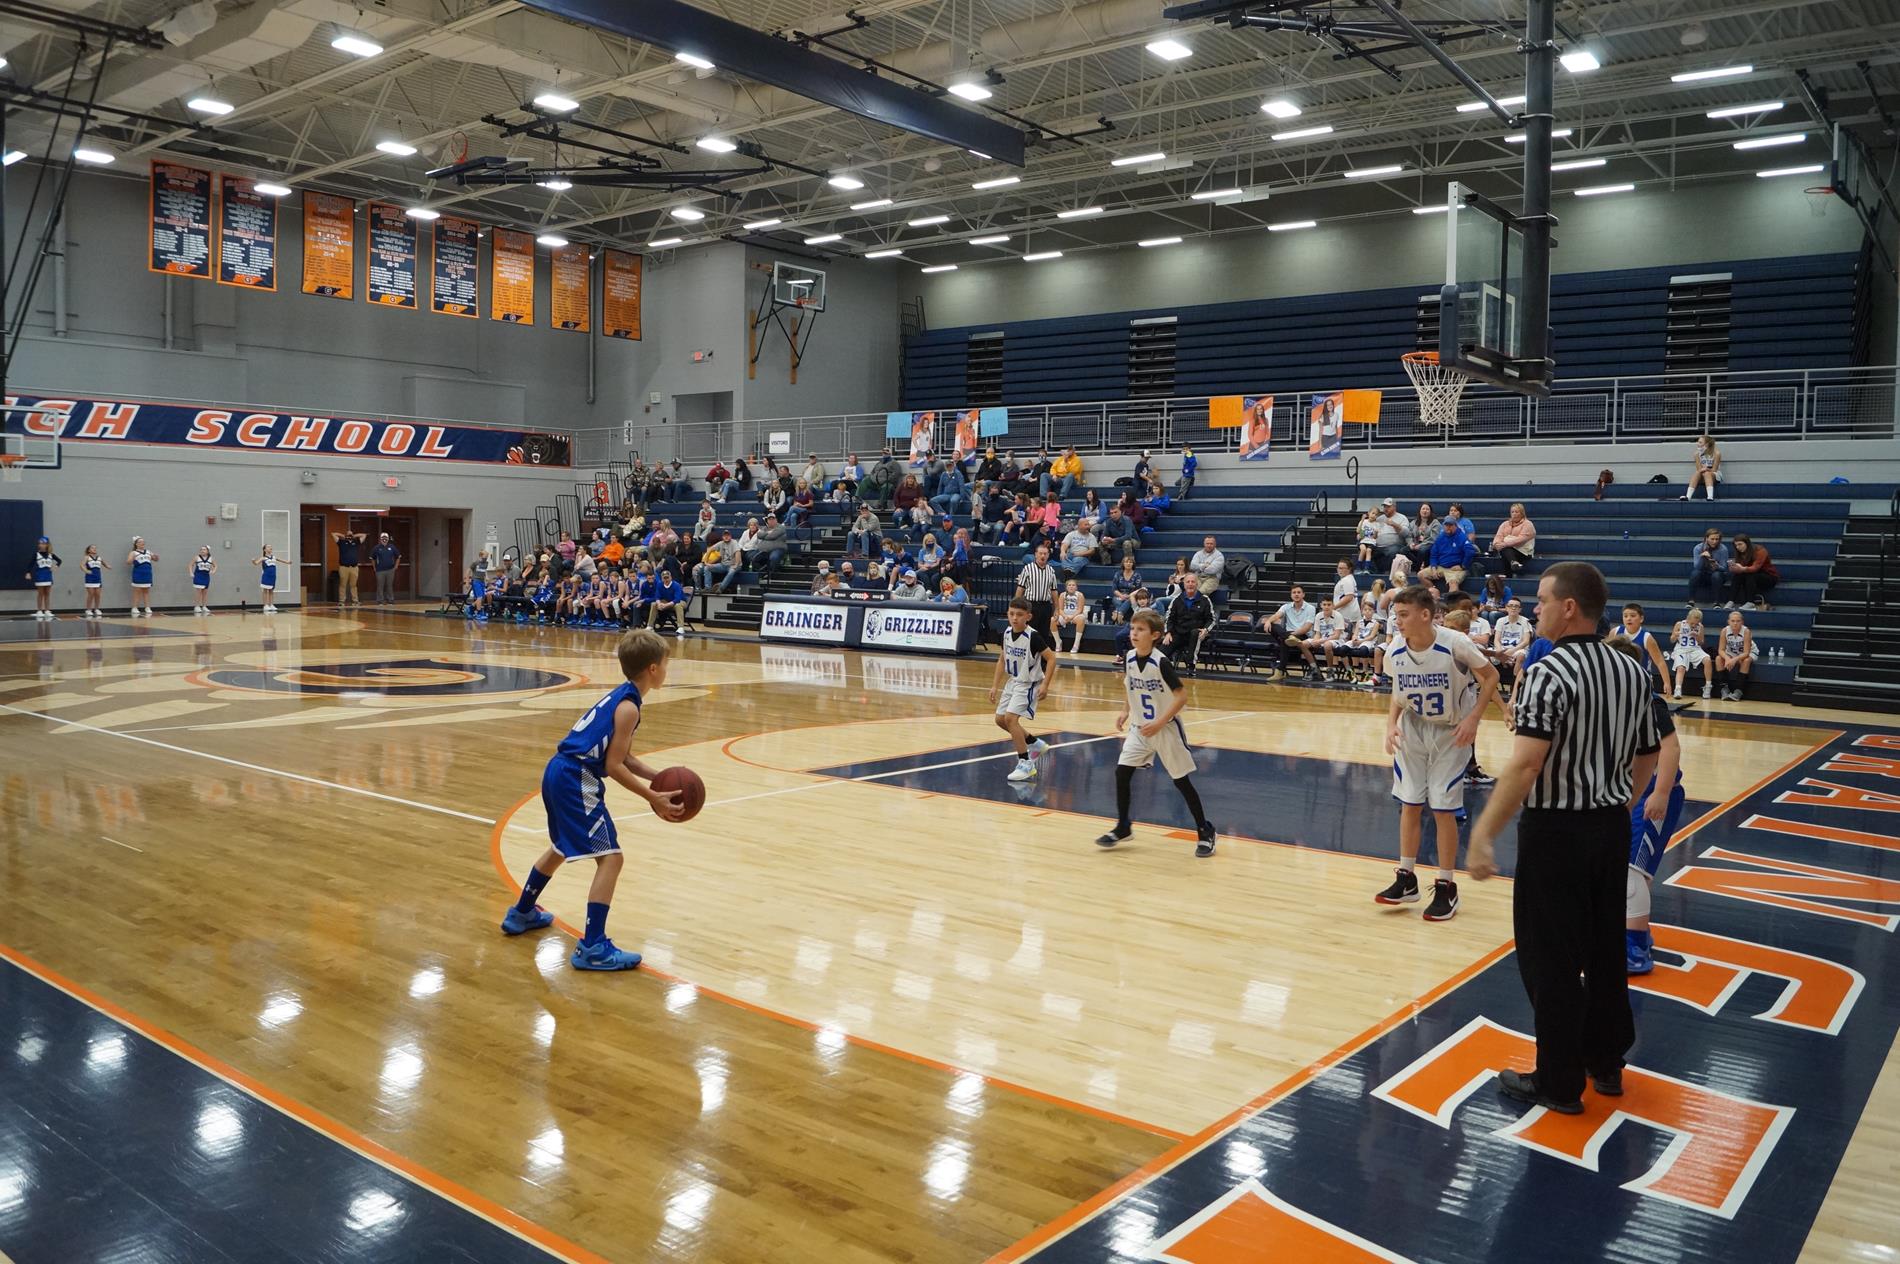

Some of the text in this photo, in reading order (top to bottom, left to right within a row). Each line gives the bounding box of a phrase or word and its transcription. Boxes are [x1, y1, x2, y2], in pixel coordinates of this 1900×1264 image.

[186, 410, 454, 458] SCHOOL
[766, 610, 843, 630] GRAINGER
[884, 616, 953, 635] GRIZZLIES
[1681, 636, 1696, 647] 33
[1397, 672, 1449, 691] BUCCANEERS
[1141, 694, 1155, 719] 5
[1406, 692, 1444, 717] 33
